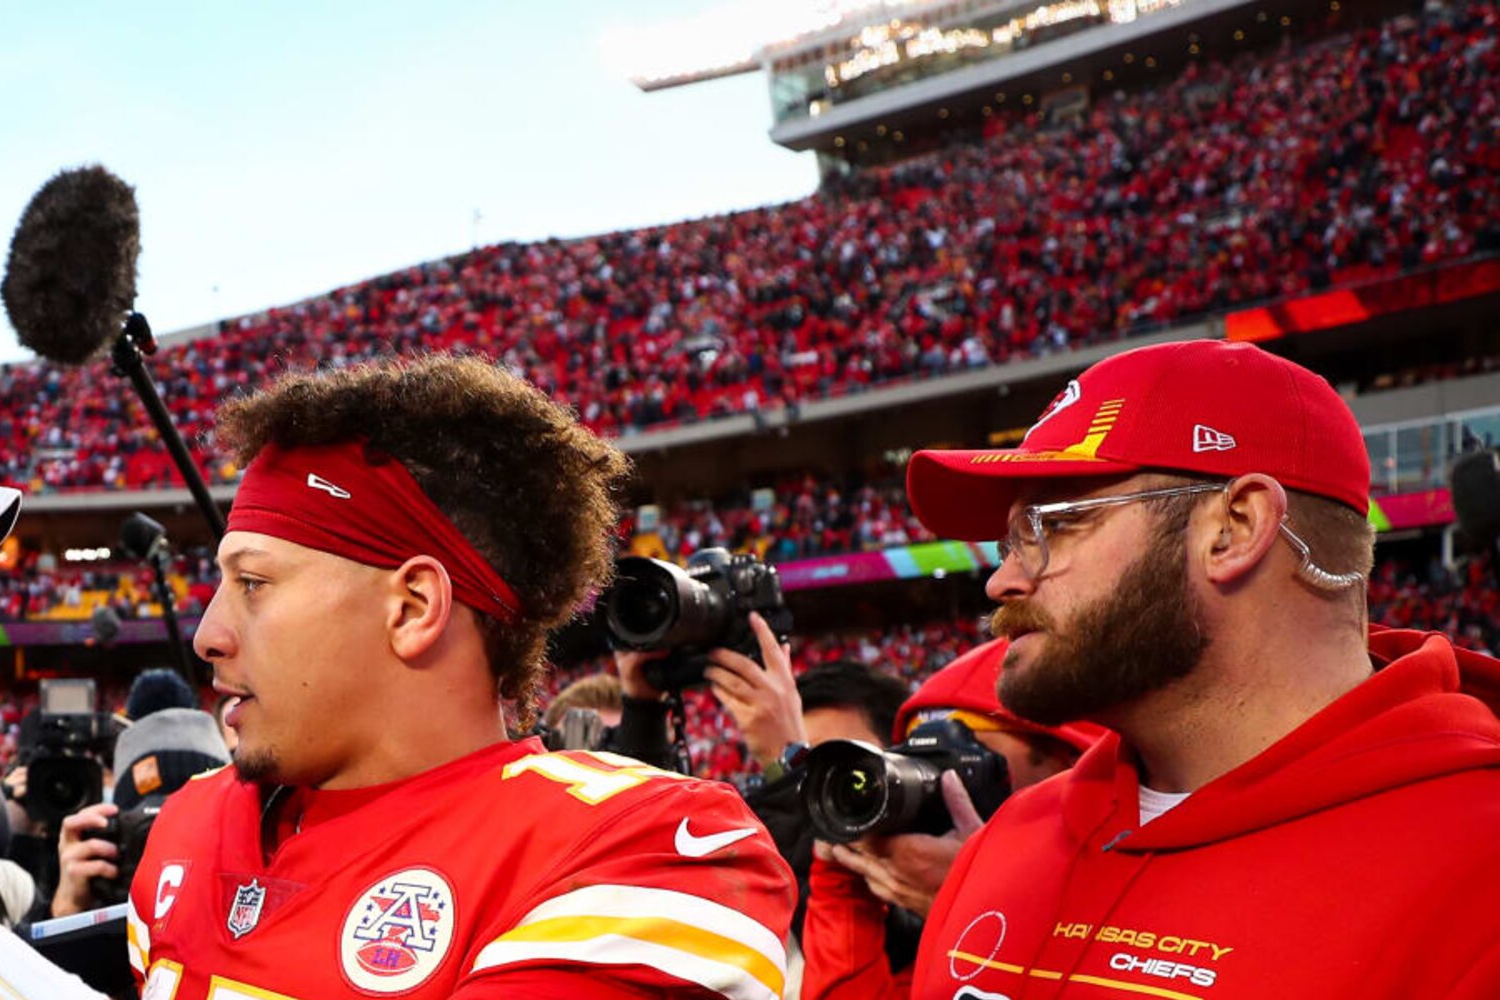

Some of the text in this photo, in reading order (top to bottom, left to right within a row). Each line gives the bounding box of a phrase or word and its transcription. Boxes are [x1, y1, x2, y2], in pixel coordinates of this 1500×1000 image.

[154, 864, 185, 919] C
[1157, 935, 1234, 961] CITY
[1109, 952, 1218, 987] CHIEFS
